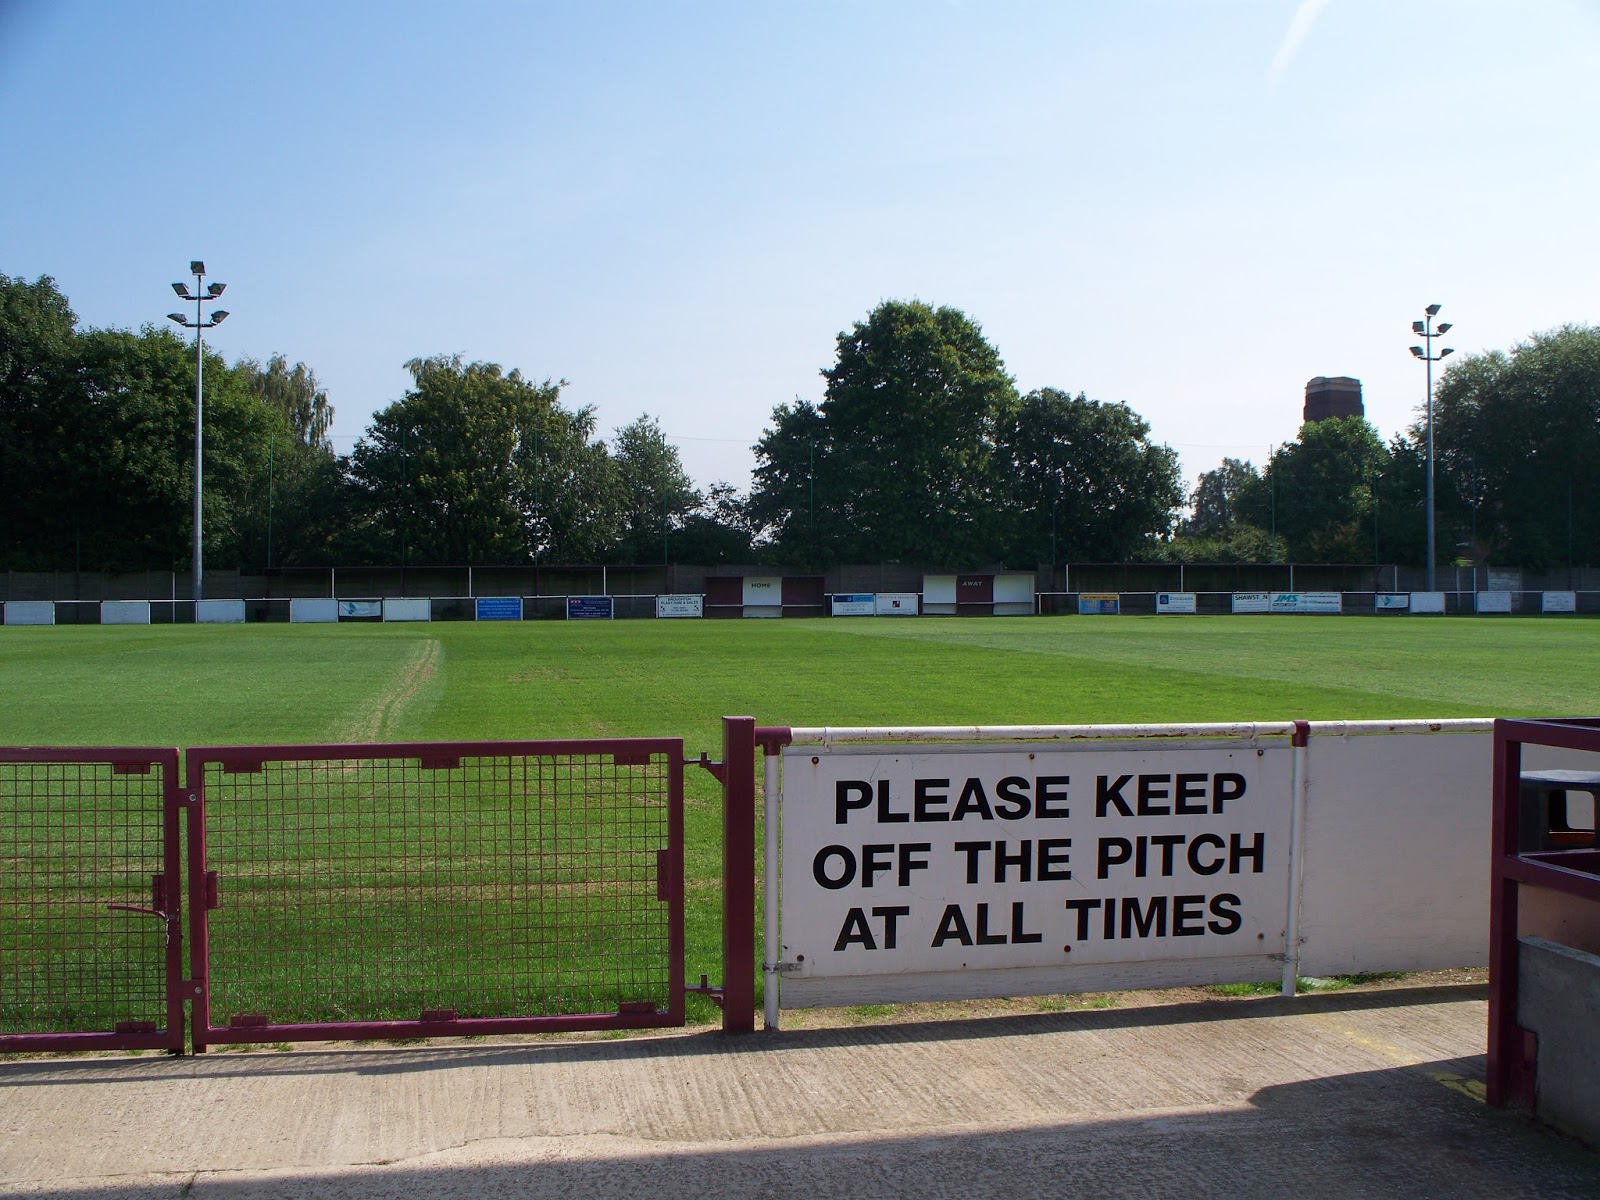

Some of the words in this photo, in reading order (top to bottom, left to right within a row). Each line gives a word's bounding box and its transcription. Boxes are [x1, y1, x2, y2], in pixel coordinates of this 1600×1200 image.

[1273, 594, 1300, 602] JMS
[835, 775, 1070, 825] PLEASE
[1095, 772, 1247, 818] KEEP
[812, 842, 932, 890] OFF
[954, 838, 1072, 884] THE
[1097, 832, 1265, 880] PITCH
[833, 905, 909, 952] AT
[931, 901, 1042, 948] ALL
[1066, 893, 1242, 941] TIMES
